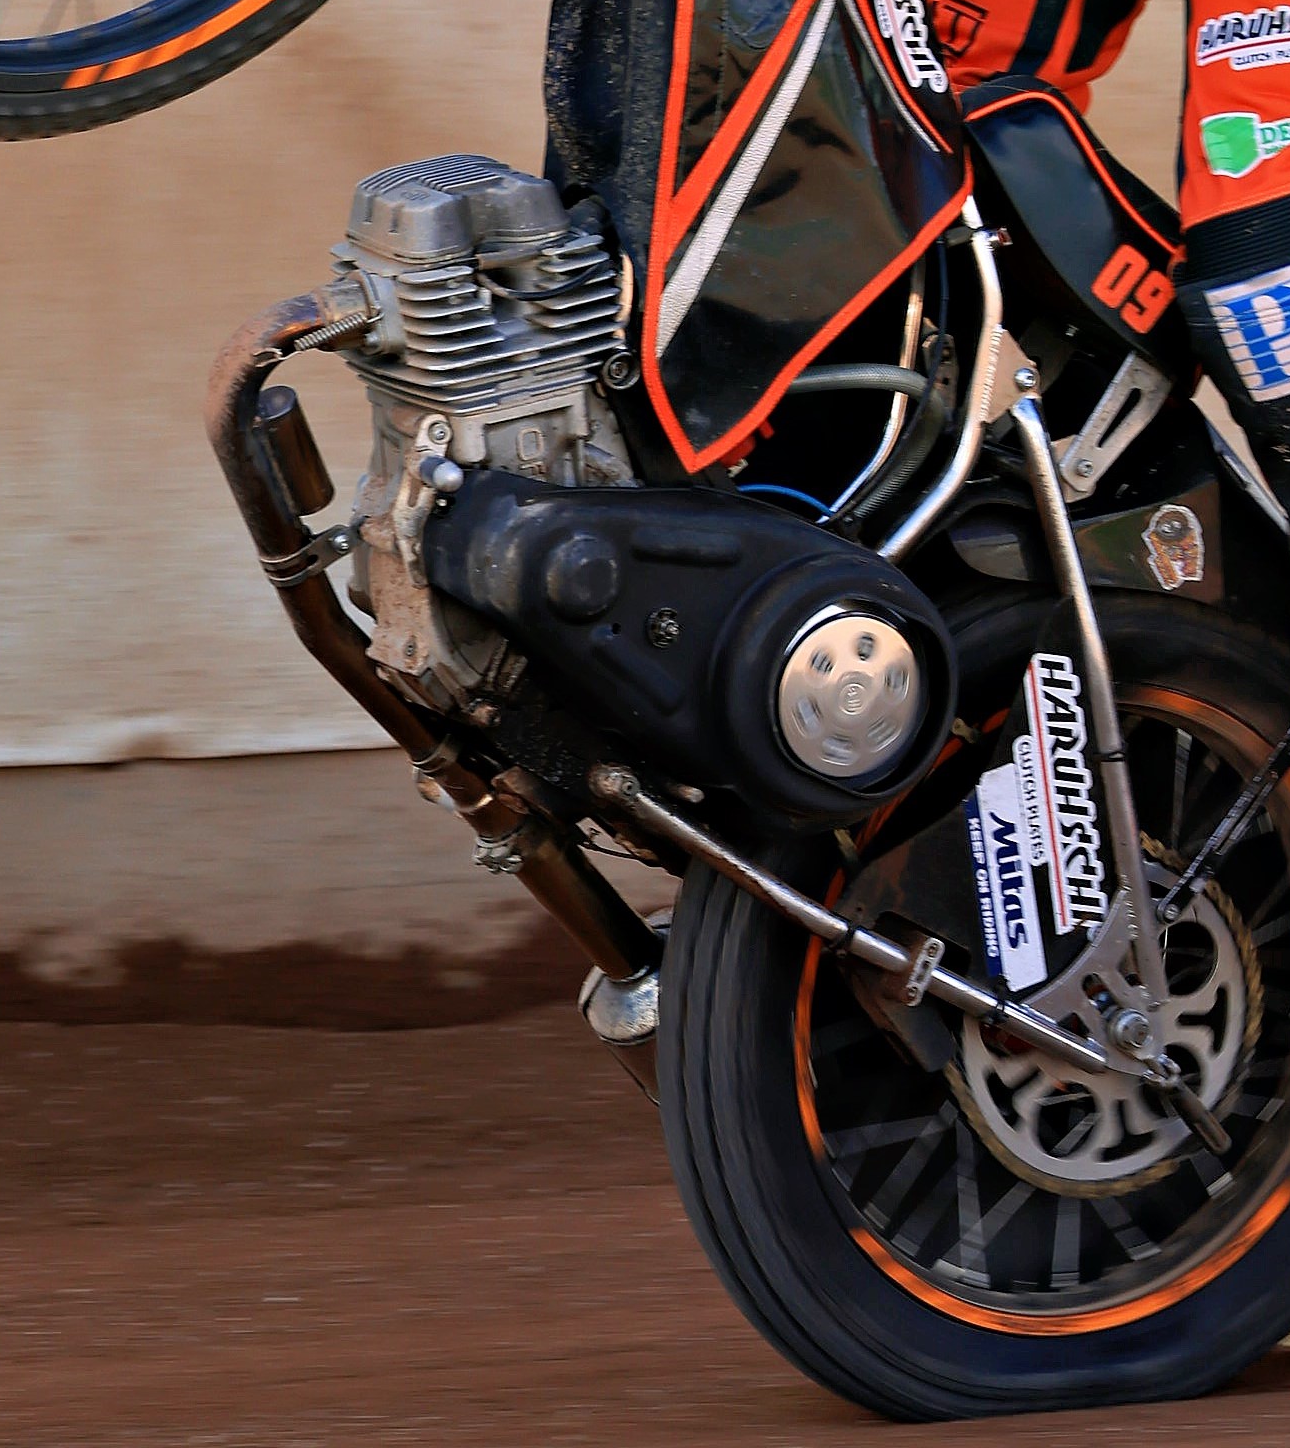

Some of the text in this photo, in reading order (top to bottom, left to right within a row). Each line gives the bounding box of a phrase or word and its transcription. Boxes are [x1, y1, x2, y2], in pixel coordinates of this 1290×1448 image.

[1091, 244, 1177, 334] 09
[968, 816, 983, 864] KEEP
[990, 811, 1029, 951] Mitas
